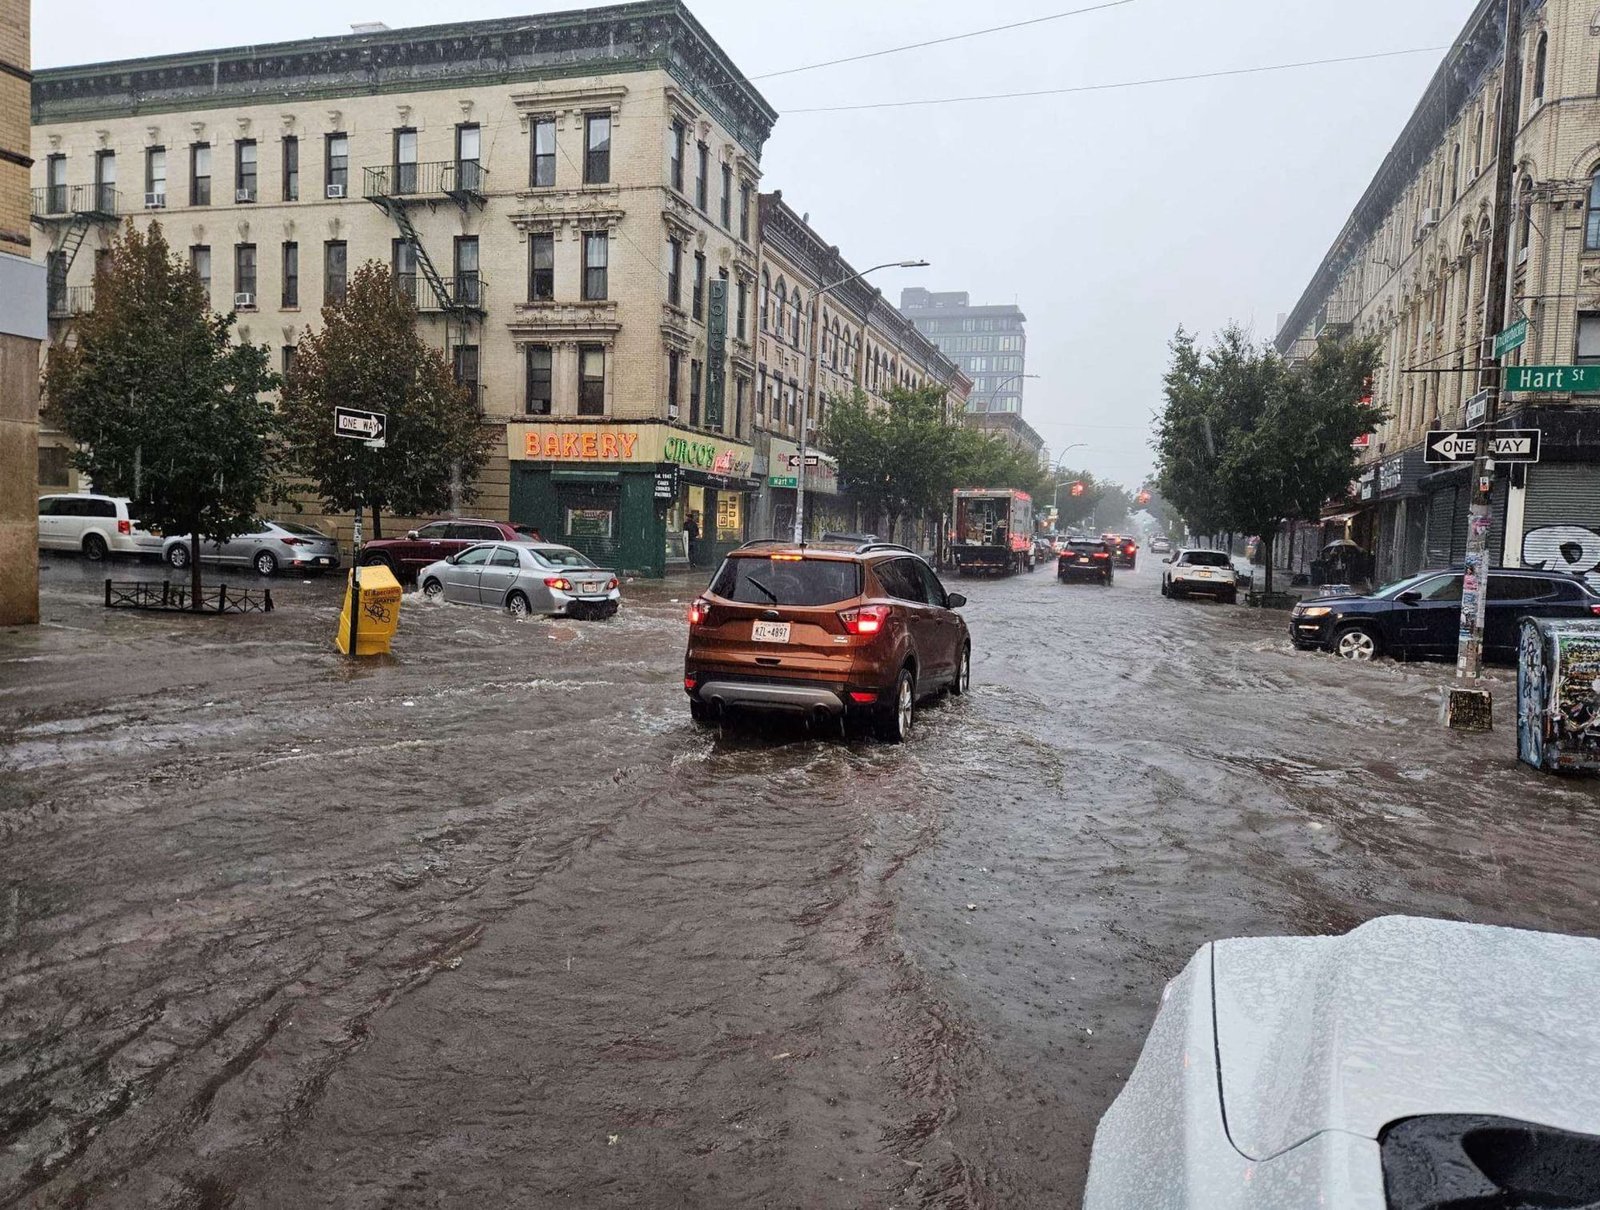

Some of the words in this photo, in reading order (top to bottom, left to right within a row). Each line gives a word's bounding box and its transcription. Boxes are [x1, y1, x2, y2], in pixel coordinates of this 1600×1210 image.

[1520, 369, 1563, 388] Hart
[1572, 369, 1584, 381] St
[343, 416, 358, 429] ONE
[363, 420, 379, 432] WAY
[525, 432, 637, 458] BAKERY
[664, 436, 715, 468] CIRCO'S
[1443, 440, 1474, 452] ONE
[774, 478, 787, 486] Hart
